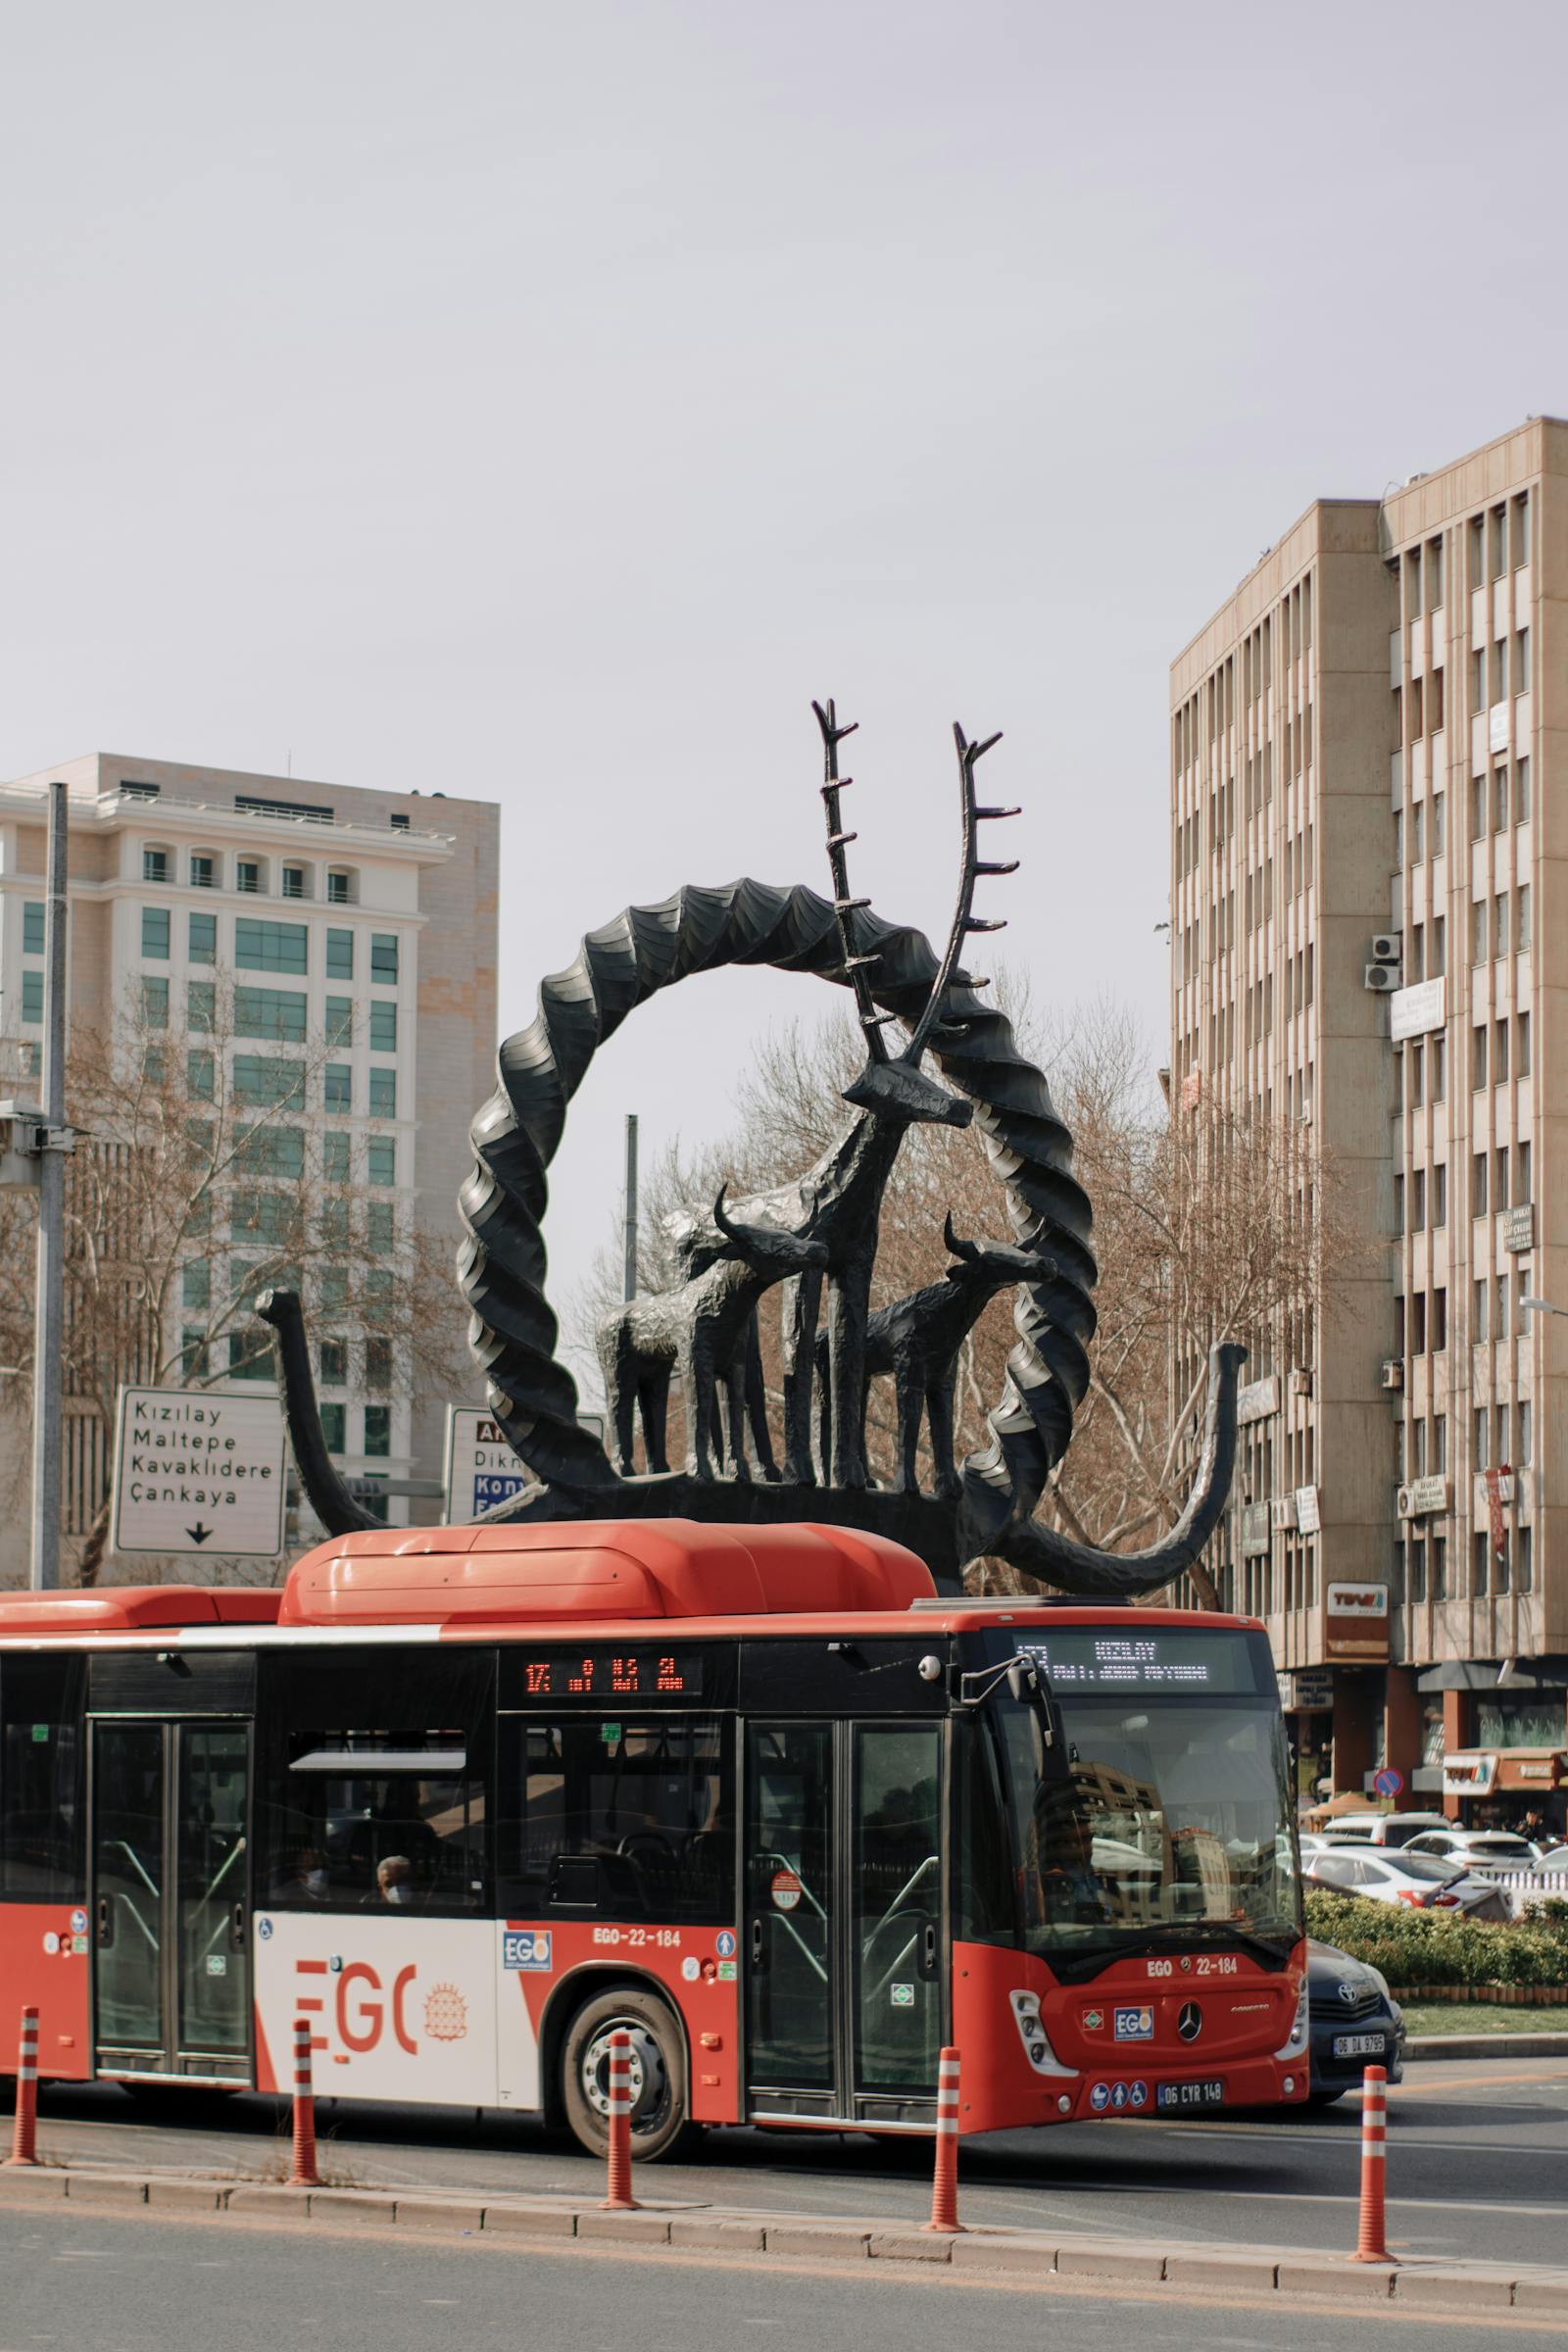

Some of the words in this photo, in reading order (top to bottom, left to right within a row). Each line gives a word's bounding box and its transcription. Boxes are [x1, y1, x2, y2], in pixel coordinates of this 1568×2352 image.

[135, 1401, 221, 1427] Kızılay
[133, 1429, 236, 1453] Maltepe
[131, 1455, 271, 1479] Kavaklıdere
[130, 1482, 236, 1507] Çankaya
[593, 1927, 681, 1947] EGO-22-184
[505, 1937, 550, 1962] EGO
[1147, 1960, 1173, 1977] EGO
[1197, 1957, 1237, 1975] 22-184
[1117, 2013, 1152, 2034] EGO
[1338, 2038, 1348, 2053] 06
[1165, 2086, 1176, 2104] 06
[1203, 2082, 1221, 2100] 148
